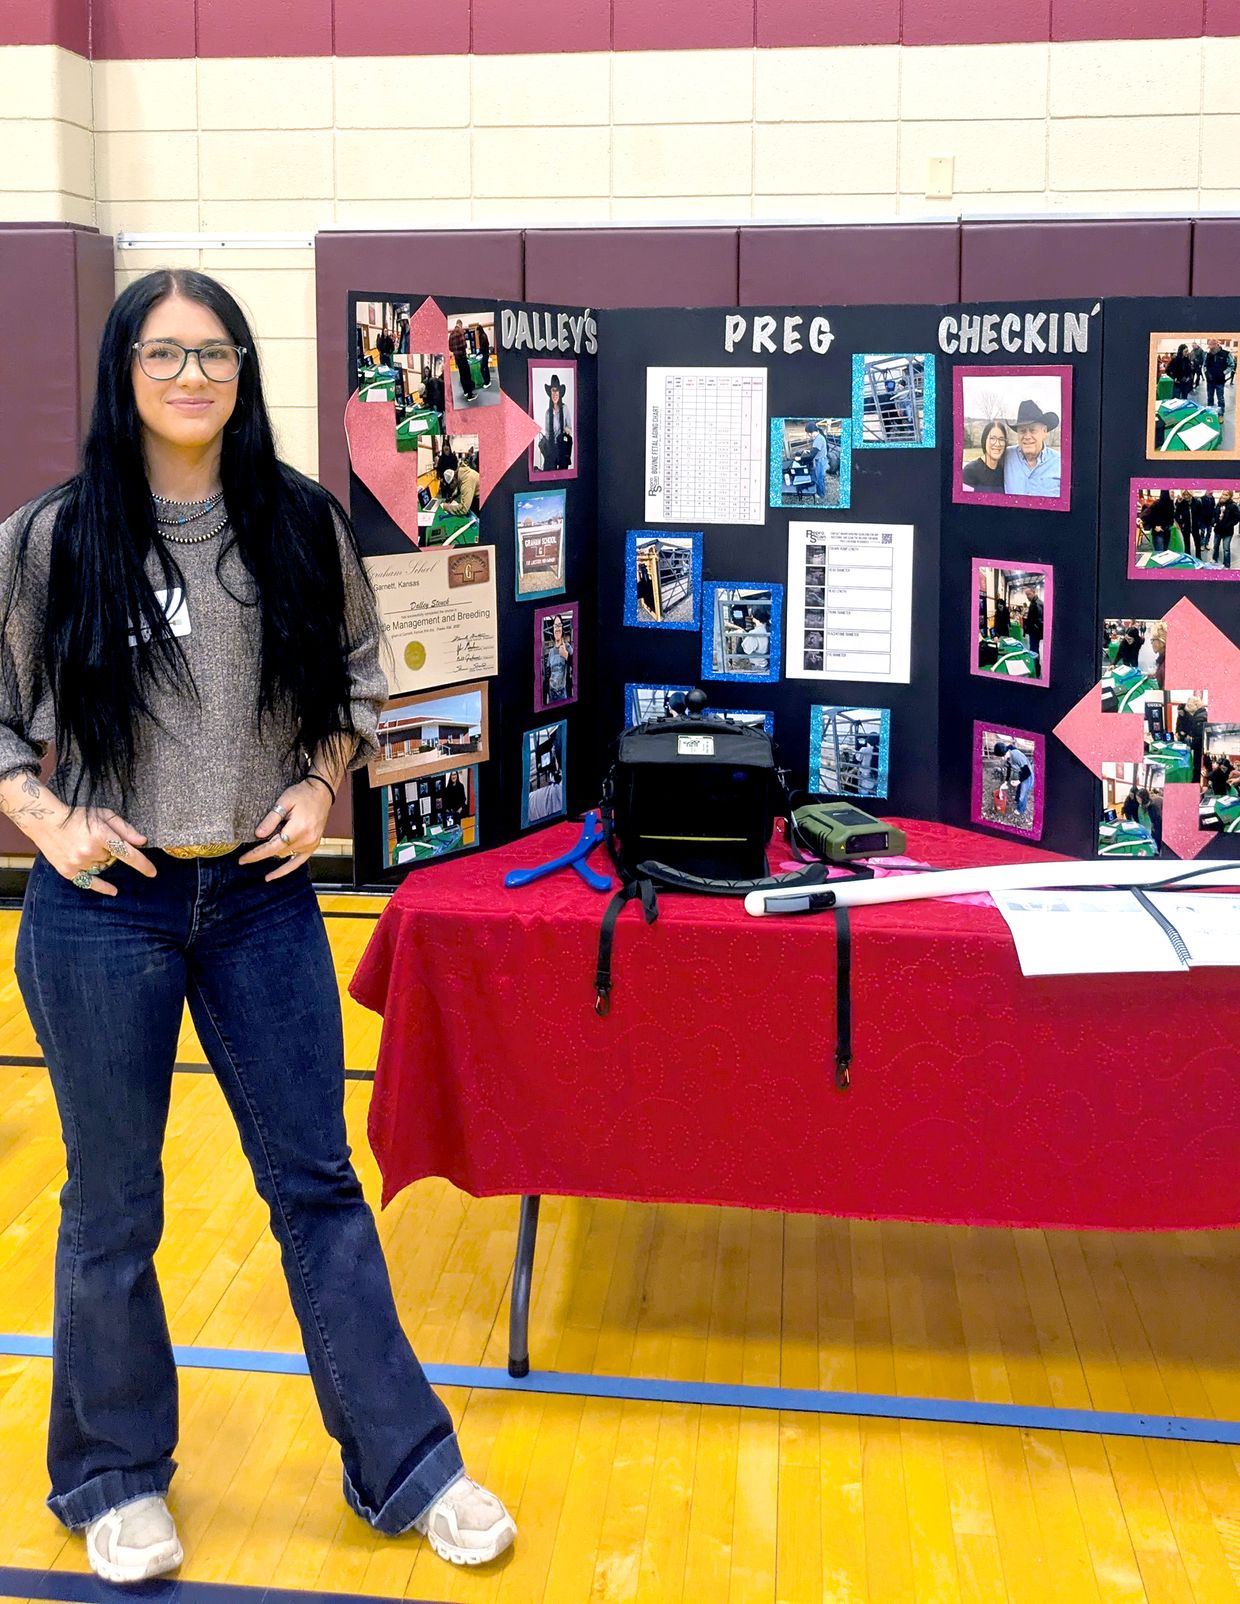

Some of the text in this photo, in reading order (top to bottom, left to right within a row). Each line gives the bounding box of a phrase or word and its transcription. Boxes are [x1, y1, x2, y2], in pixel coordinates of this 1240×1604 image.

[500, 302, 1100, 354] DALLEY'S PREG CHECKIN'
[392, 616, 440, 632] Management
[442, 613, 455, 622] and
[458, 610, 490, 620] Breeding
